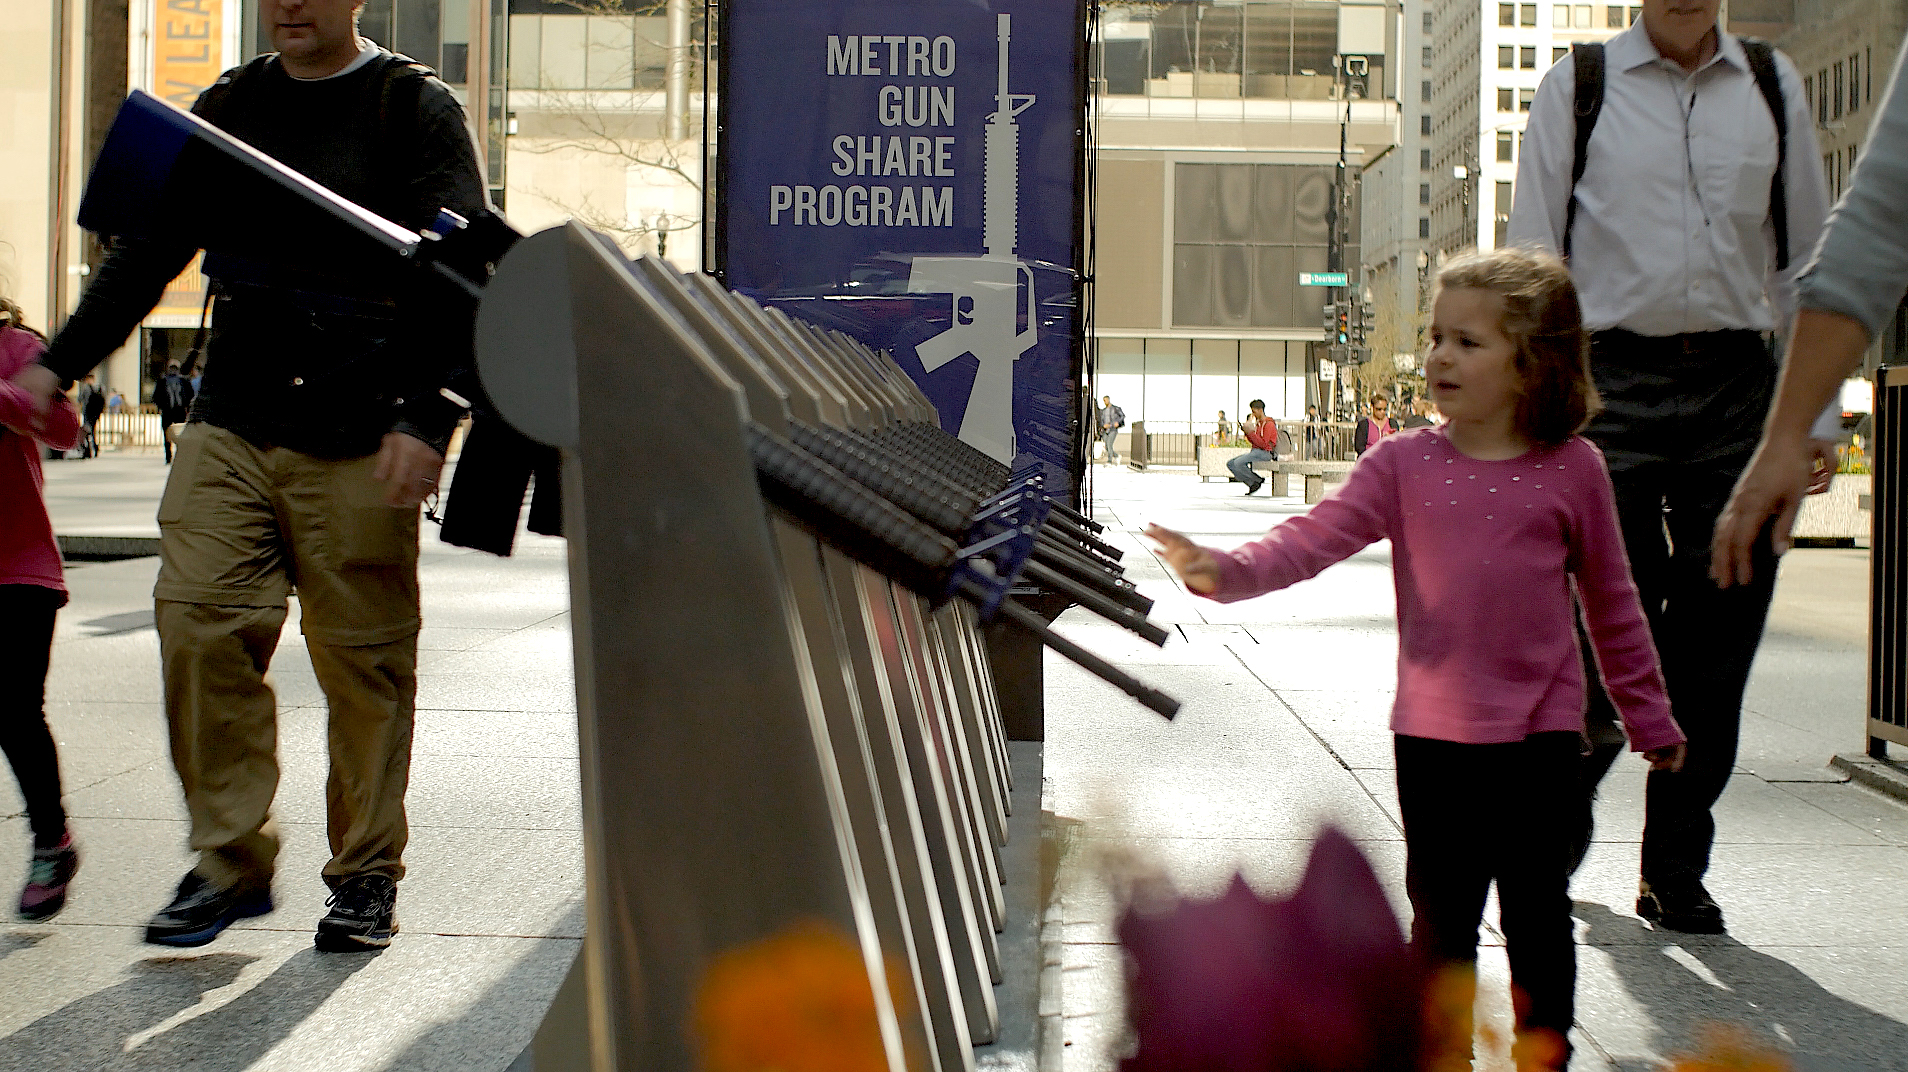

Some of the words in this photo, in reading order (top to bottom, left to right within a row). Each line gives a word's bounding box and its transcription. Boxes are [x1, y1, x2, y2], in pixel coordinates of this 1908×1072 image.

[827, 35, 956, 77] METRO
[878, 85, 955, 127] GUN
[831, 135, 955, 177] SHARE
[770, 184, 954, 227] PROGRAM
[1314, 274, 1342, 283] Dearborn
